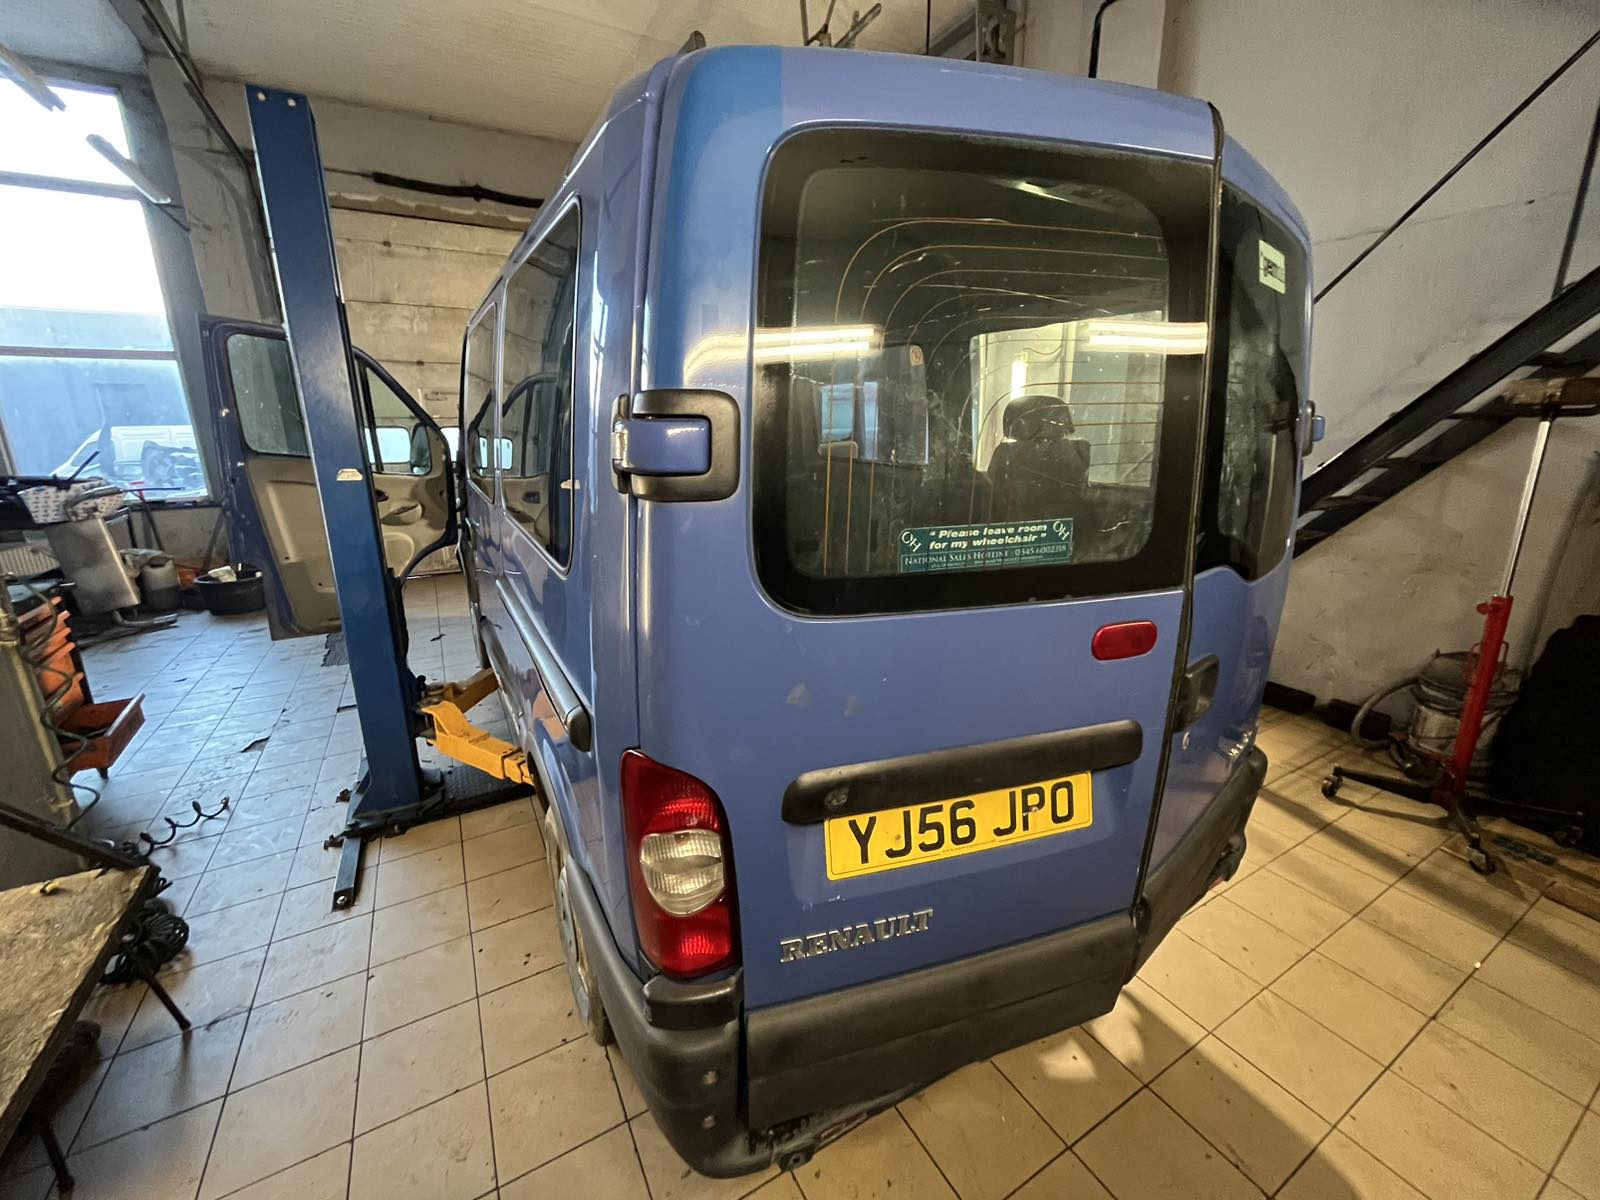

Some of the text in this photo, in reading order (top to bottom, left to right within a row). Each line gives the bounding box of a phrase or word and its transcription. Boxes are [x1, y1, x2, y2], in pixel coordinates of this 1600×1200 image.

[929, 541, 949, 550] for
[950, 540, 968, 549] my
[972, 533, 1038, 546] wheelchair
[938, 529, 980, 539] Please
[983, 527, 1015, 536] leave
[1018, 524, 1047, 533] room
[848, 780, 1074, 864] YJ56 JPO
[780, 908, 934, 963] RENAULT
